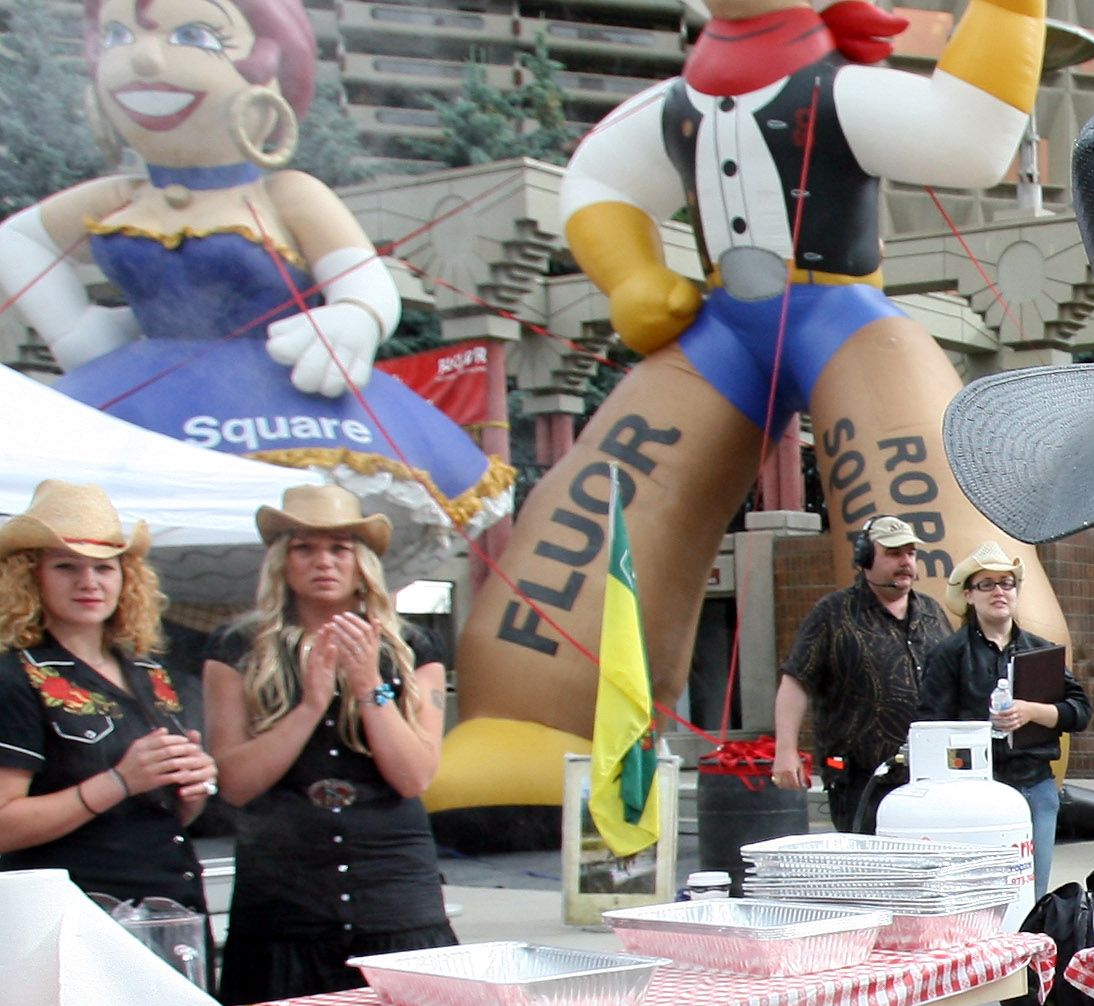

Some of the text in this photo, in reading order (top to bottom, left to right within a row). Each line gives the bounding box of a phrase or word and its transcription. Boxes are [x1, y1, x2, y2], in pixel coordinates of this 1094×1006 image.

[183, 415, 373, 450] Square
[823, 418, 877, 545] SQU
[497, 413, 682, 657] FLUOR
[877, 436, 955, 579] ROPE
